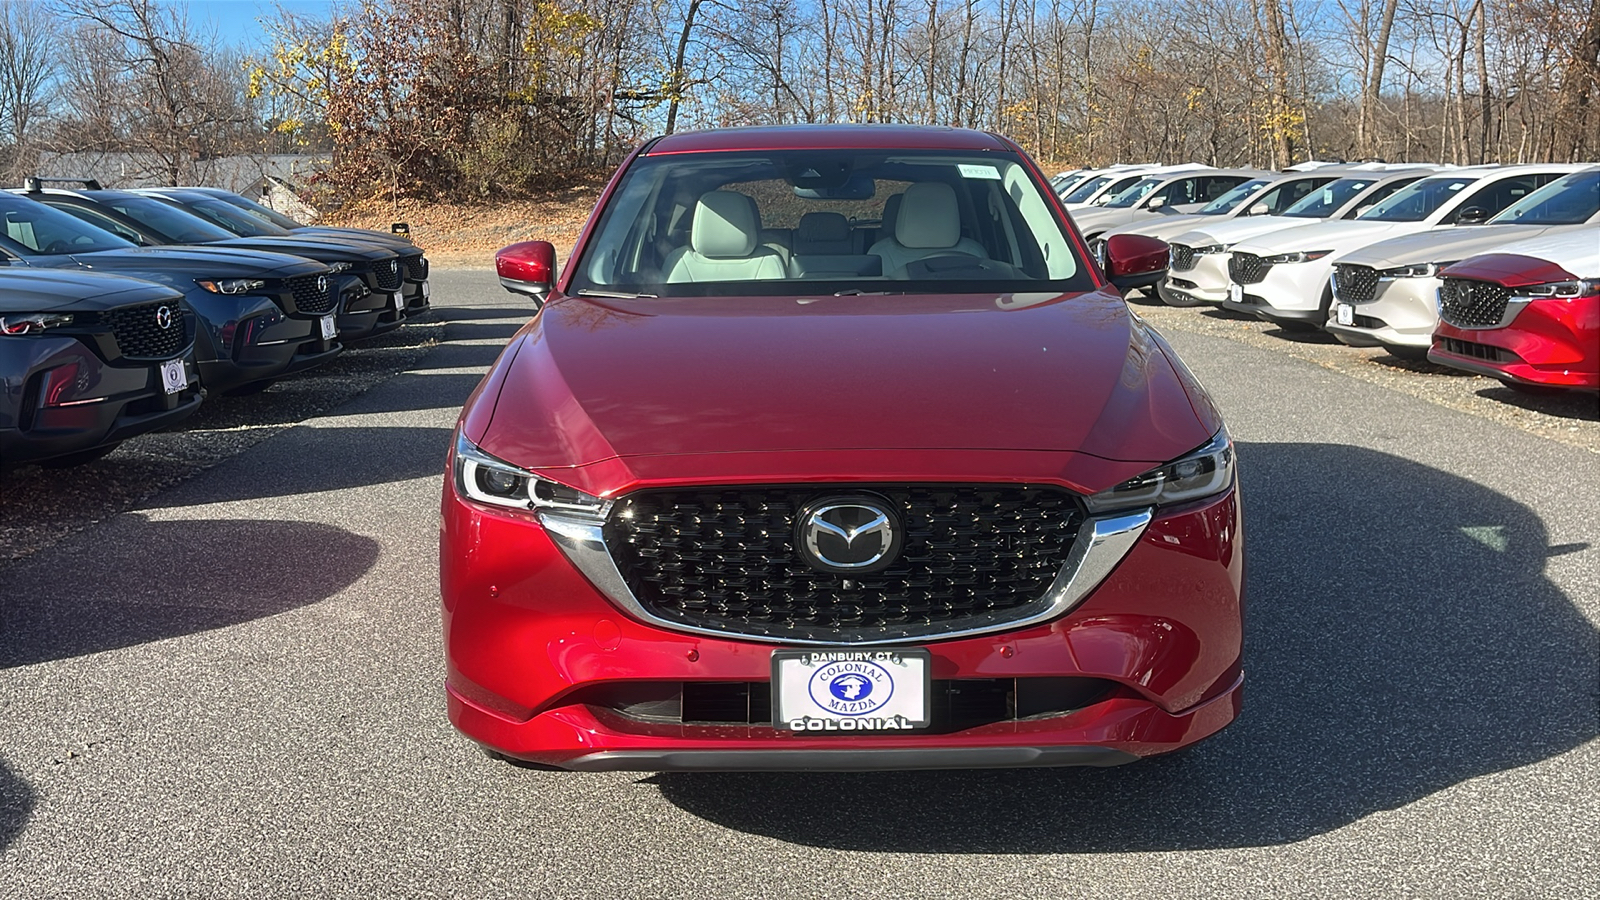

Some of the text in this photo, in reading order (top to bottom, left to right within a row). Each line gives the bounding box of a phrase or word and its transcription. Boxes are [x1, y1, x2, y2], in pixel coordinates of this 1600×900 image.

[875, 652, 893, 661] CT
[820, 663, 882, 683] COLONIAL
[828, 698, 877, 712] MAZDA
[790, 718, 914, 731] COLONIAL
